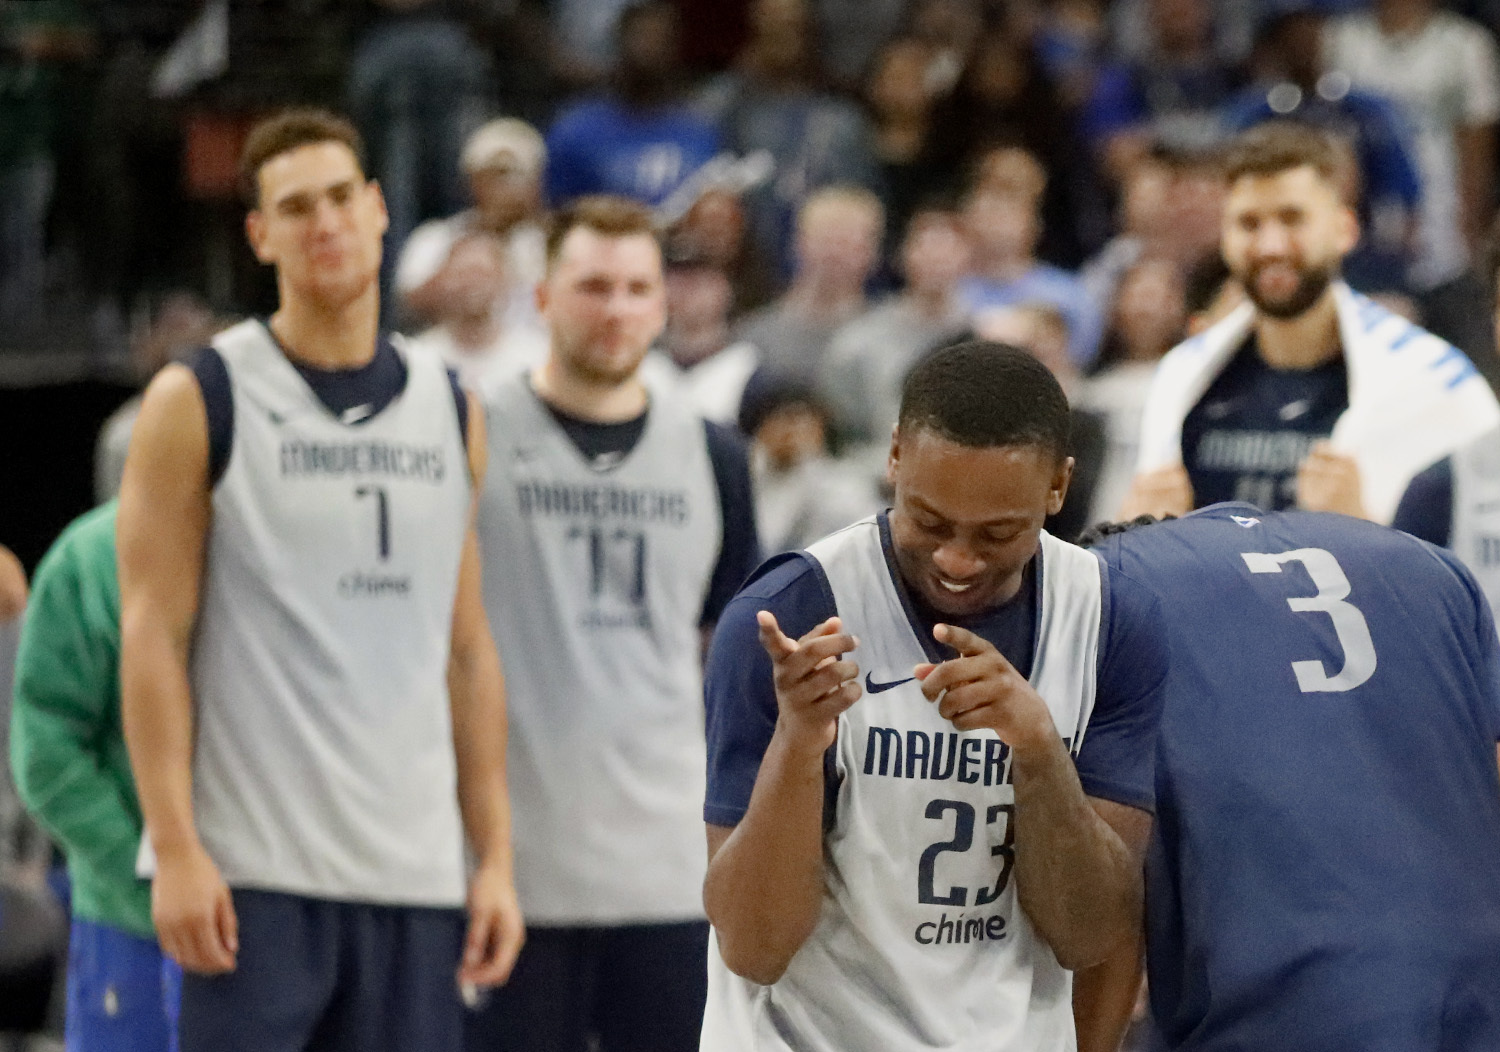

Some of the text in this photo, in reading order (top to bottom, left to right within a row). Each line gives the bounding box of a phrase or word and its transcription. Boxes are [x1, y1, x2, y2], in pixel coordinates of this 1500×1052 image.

[1240, 548, 1377, 692] 3
[918, 799, 1015, 907] 23
[915, 913, 1007, 945] chime
